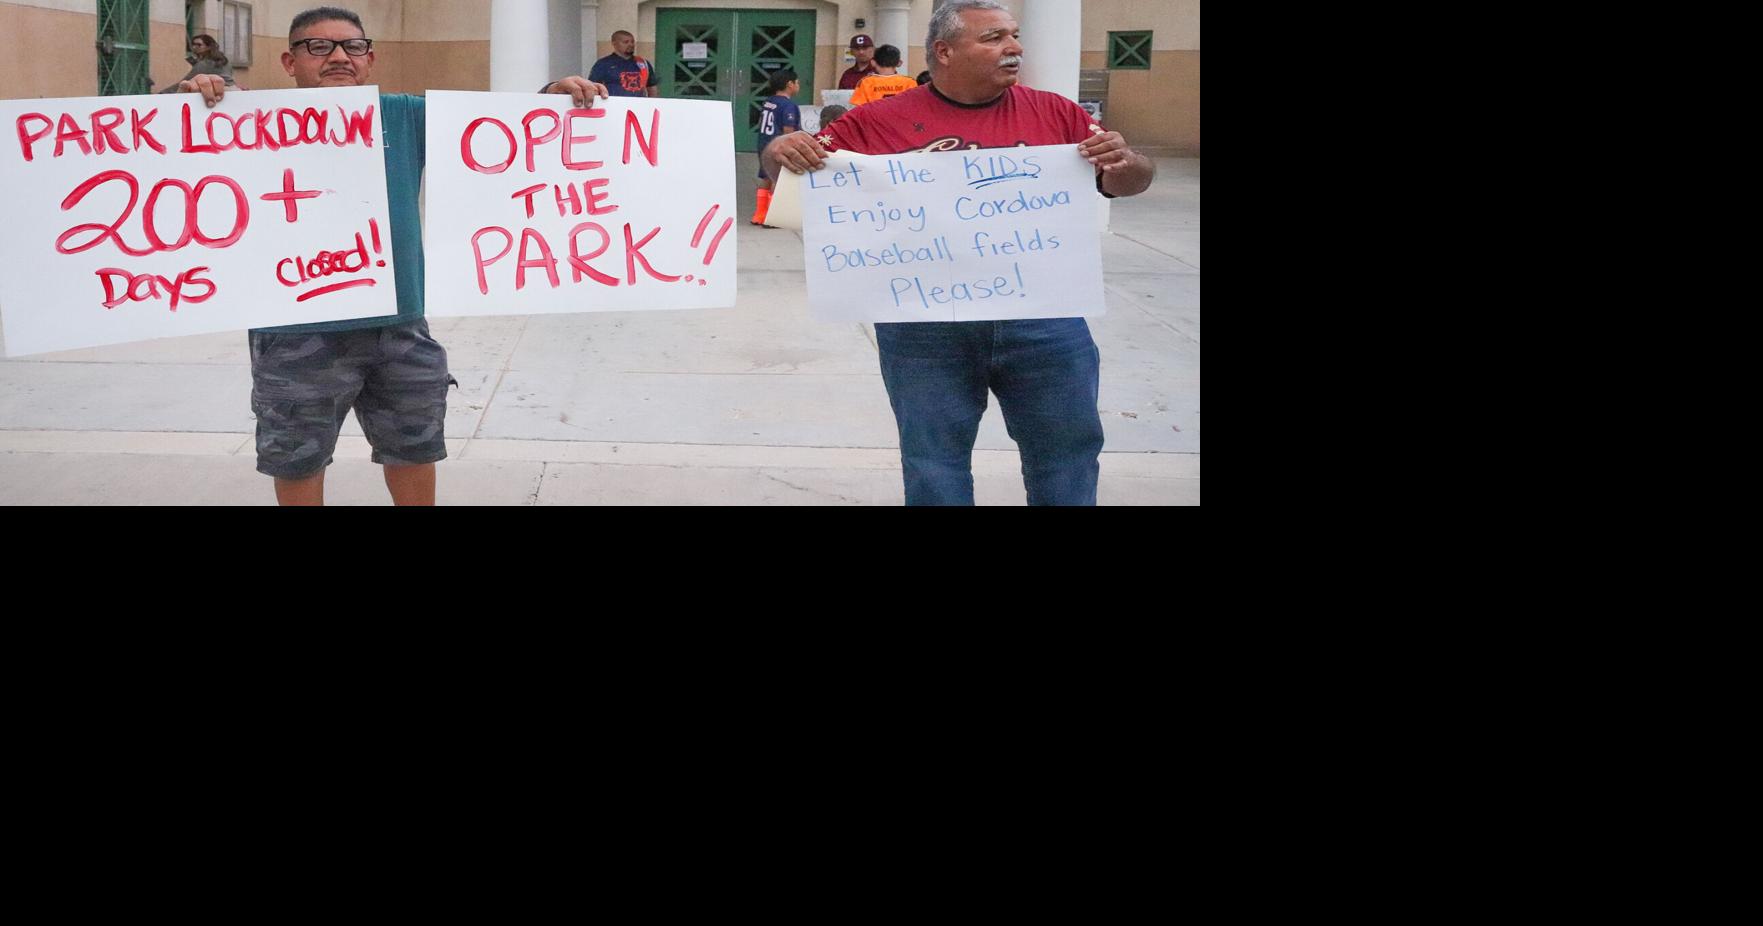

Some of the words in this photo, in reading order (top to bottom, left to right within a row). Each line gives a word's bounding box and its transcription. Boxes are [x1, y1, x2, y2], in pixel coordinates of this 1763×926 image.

[856, 36, 864, 45] C
[16, 108, 166, 162] PARK
[181, 103, 374, 154] LOCKDOWN
[460, 108, 660, 174] OPEN
[760, 110, 775, 136] 19
[808, 161, 862, 188] Let
[886, 159, 935, 184] the
[963, 155, 1042, 180] KIDS
[511, 178, 619, 218] THE
[828, 202, 926, 232] Enjoy
[955, 190, 1071, 222] Cordova
[822, 235, 954, 272] Baseball
[973, 229, 1060, 259] fields
[890, 262, 1026, 309] Please!
